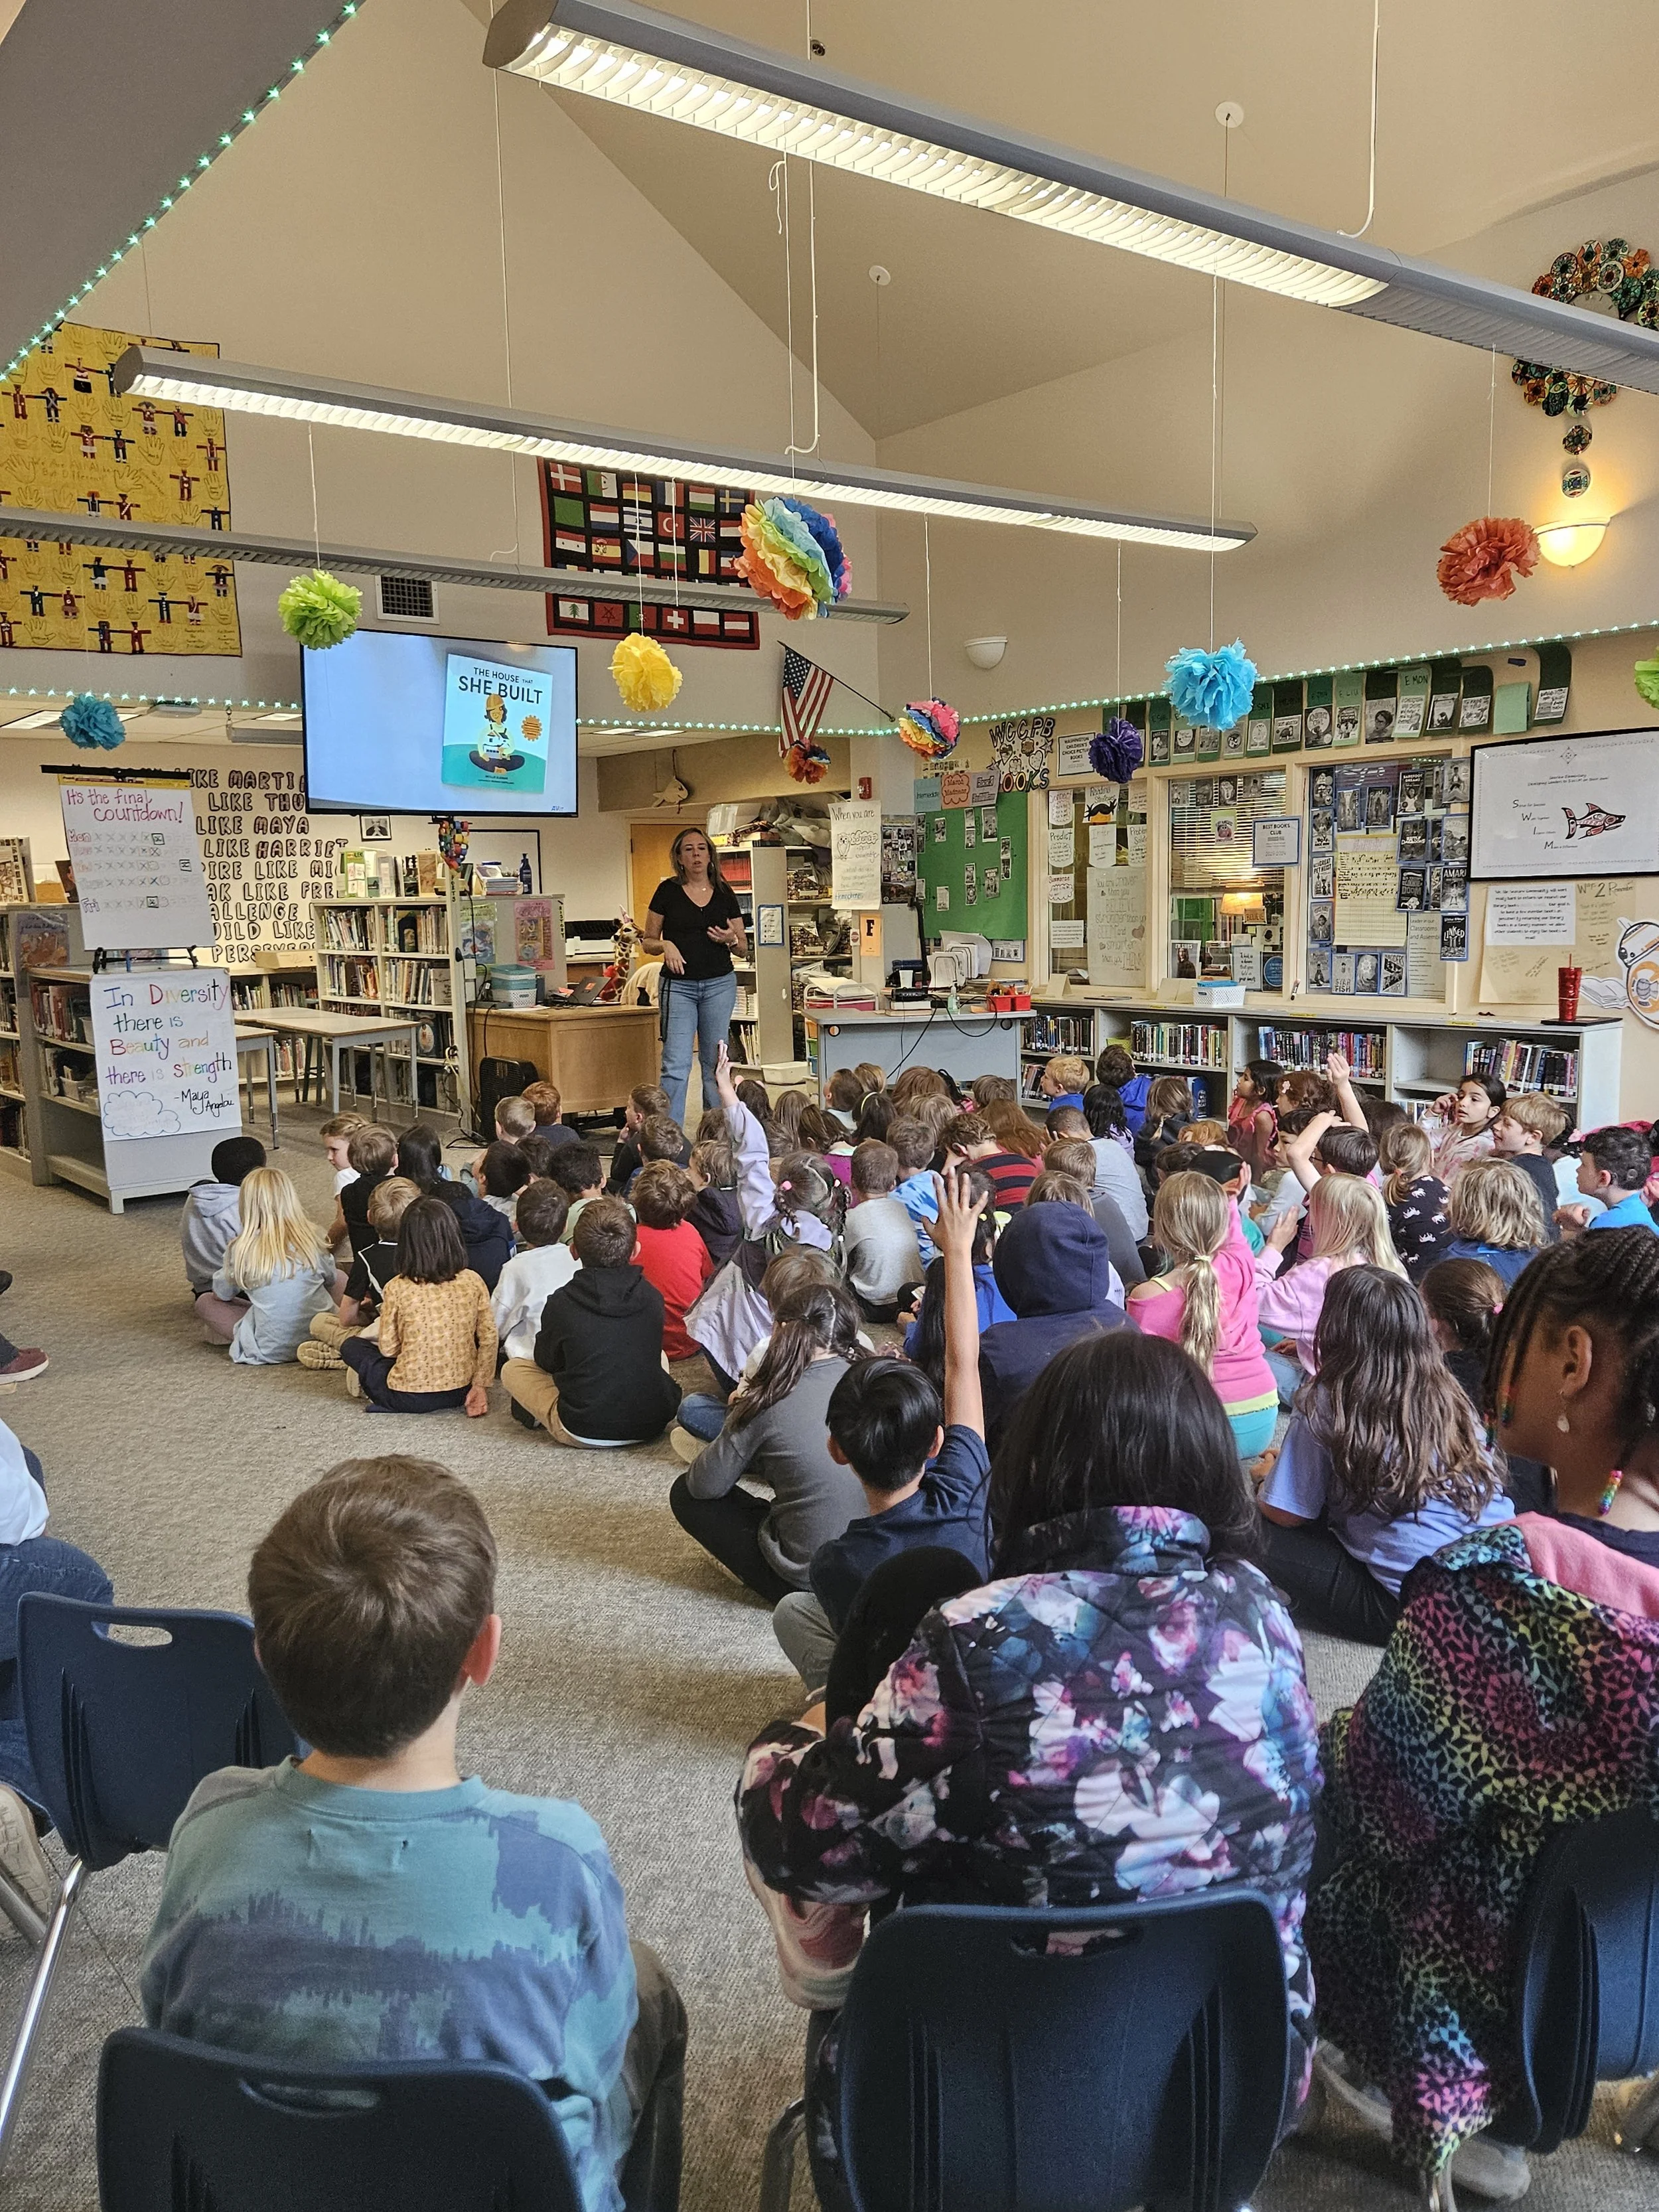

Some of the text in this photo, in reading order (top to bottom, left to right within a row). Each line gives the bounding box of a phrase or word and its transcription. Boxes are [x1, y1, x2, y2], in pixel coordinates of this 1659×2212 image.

[474, 667, 490, 678] THE
[492, 670, 520, 684] HOUSE
[458, 676, 543, 704] SHE BUILT
[66, 788, 153, 805] It's the final
[208, 792, 253, 812] LIKE
[93, 801, 184, 823] countdown!
[831, 807, 875, 821] When you are
[196, 815, 310, 835] LIKE MAYA
[67, 829, 92, 842] Mon
[1050, 830, 1073, 841] Predict
[203, 838, 349, 858] LIKE HARRIET
[255, 859, 299, 880] LIKE
[1319, 857, 1331, 867] GREAT
[1321, 863, 1332, 873] HEIST
[244, 883, 289, 901] LIKE
[1595, 882, 1606, 897] 2
[80, 897, 100, 913] Fri
[273, 921, 315, 939] LIKE
[866, 919, 875, 936] F
[1443, 925, 1465, 941] LINKED
[104, 978, 229, 1010] In Diversity
[113, 1013, 164, 1033] there
[109, 1030, 209, 1061] Beauty and
[106, 1066, 147, 1085] there
